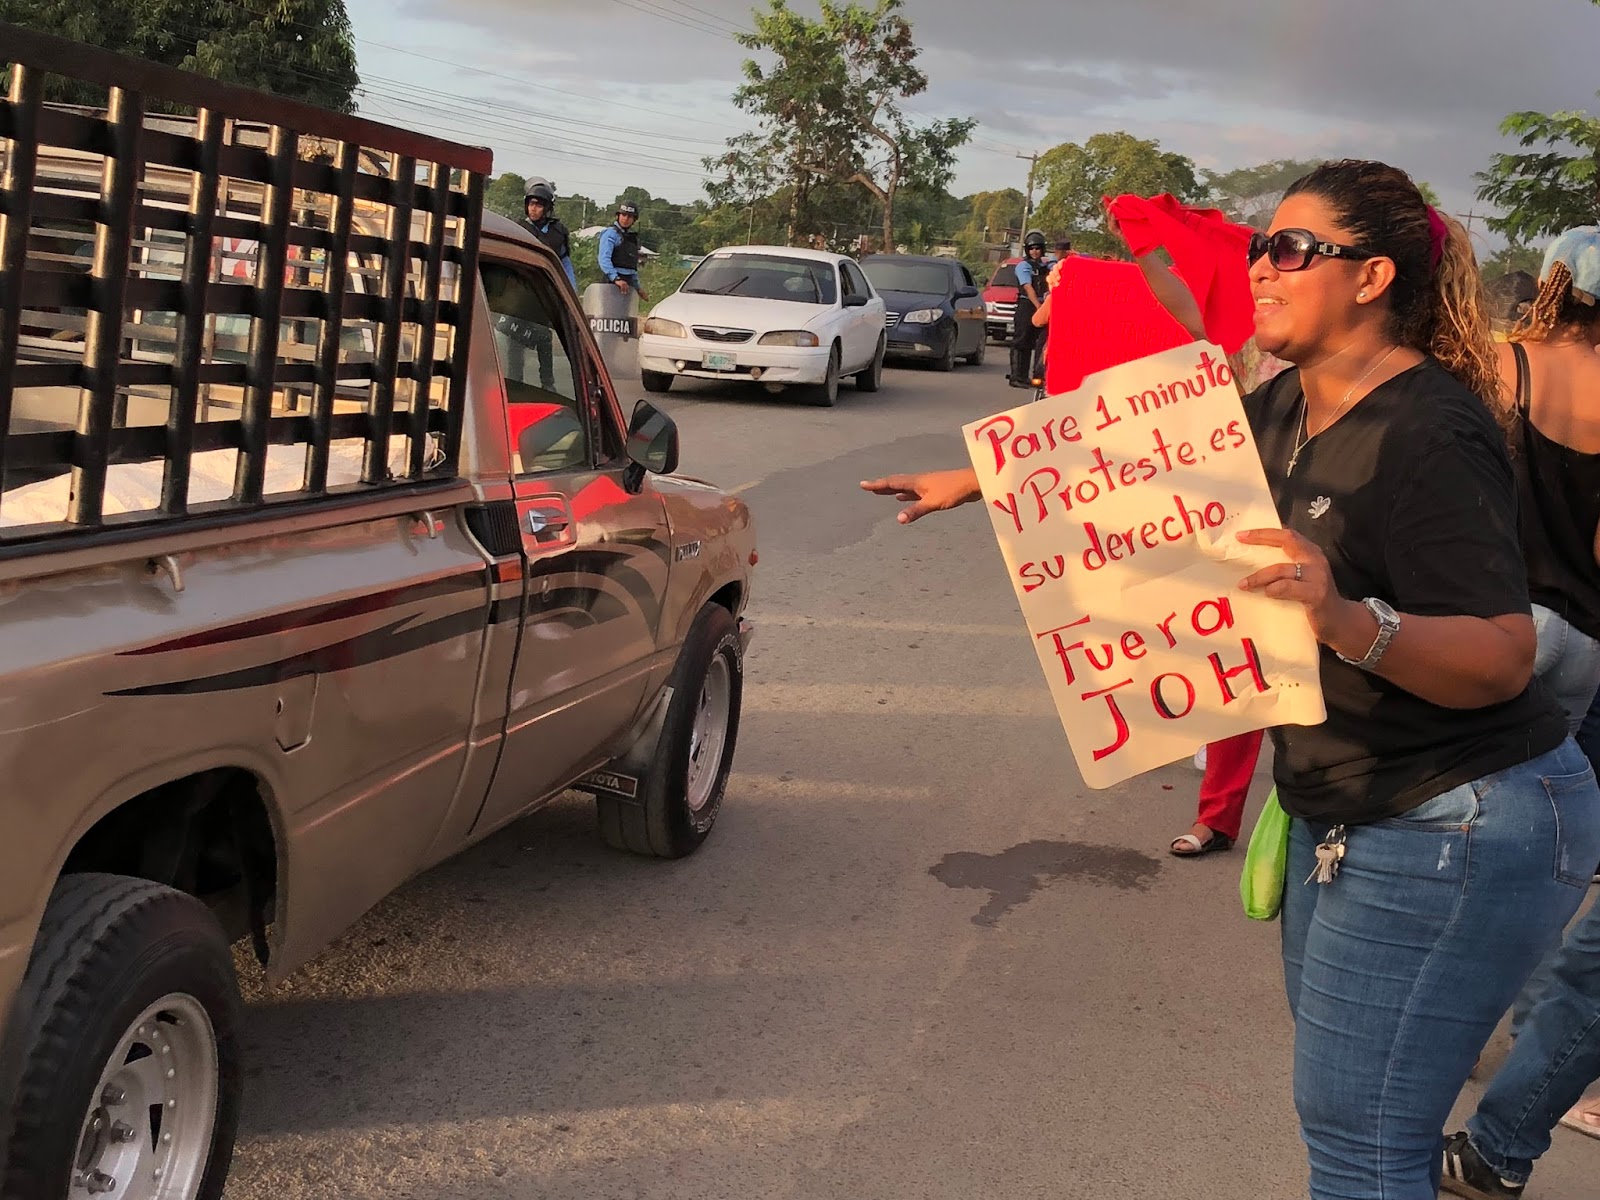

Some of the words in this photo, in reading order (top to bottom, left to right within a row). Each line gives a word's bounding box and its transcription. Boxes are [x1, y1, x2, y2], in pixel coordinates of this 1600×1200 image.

[591, 318, 630, 334] POLICIA
[975, 415, 1083, 475] Pare
[1095, 395, 1122, 431] 1
[1127, 351, 1232, 416] minuto
[1210, 417, 1247, 453] es
[1019, 554, 1065, 592] su
[1037, 596, 1235, 686] Fuera
